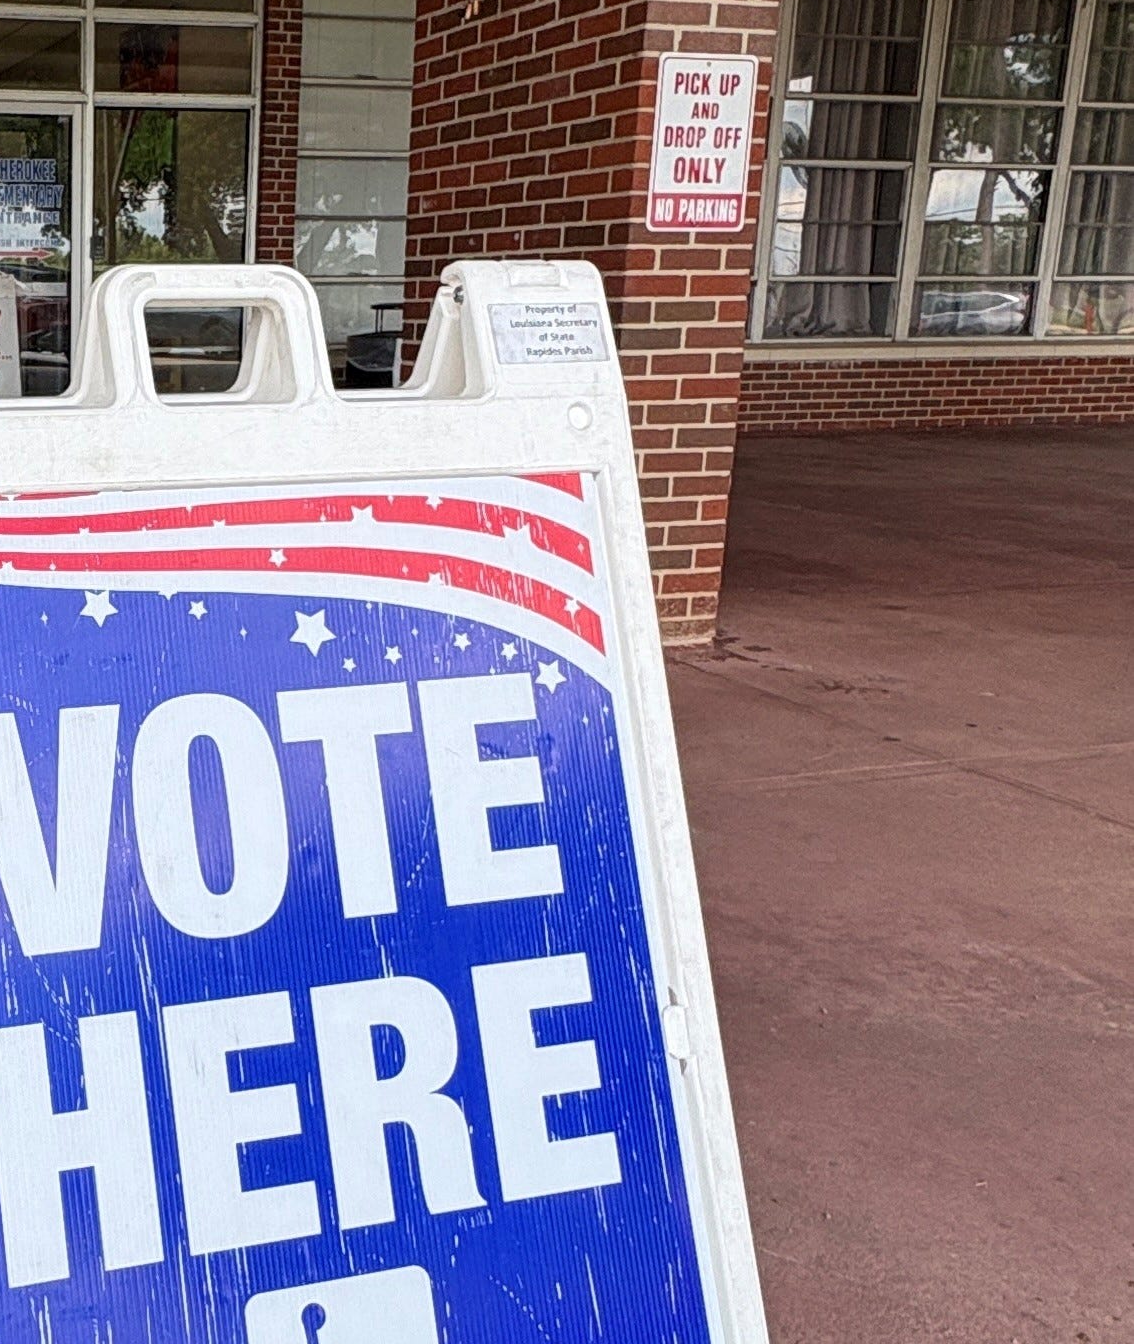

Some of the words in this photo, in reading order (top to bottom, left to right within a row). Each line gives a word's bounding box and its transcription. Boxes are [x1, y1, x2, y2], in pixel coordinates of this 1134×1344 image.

[674, 72, 711, 95] PICK
[719, 73, 741, 96] UP
[691, 102, 720, 120] AND
[664, 126, 707, 148] DROP
[713, 127, 743, 149] OFF
[673, 157, 727, 184] ONLY
[655, 198, 674, 222] NO
[678, 199, 738, 223] PARKING
[525, 305, 565, 315] Property
[567, 304, 577, 313] of
[509, 319, 553, 328] Louisiana
[554, 319, 598, 329] Secretary
[538, 332, 548, 342] of
[550, 333, 575, 342] State
[526, 347, 563, 358] Rapides
[564, 346, 593, 356] Parish
